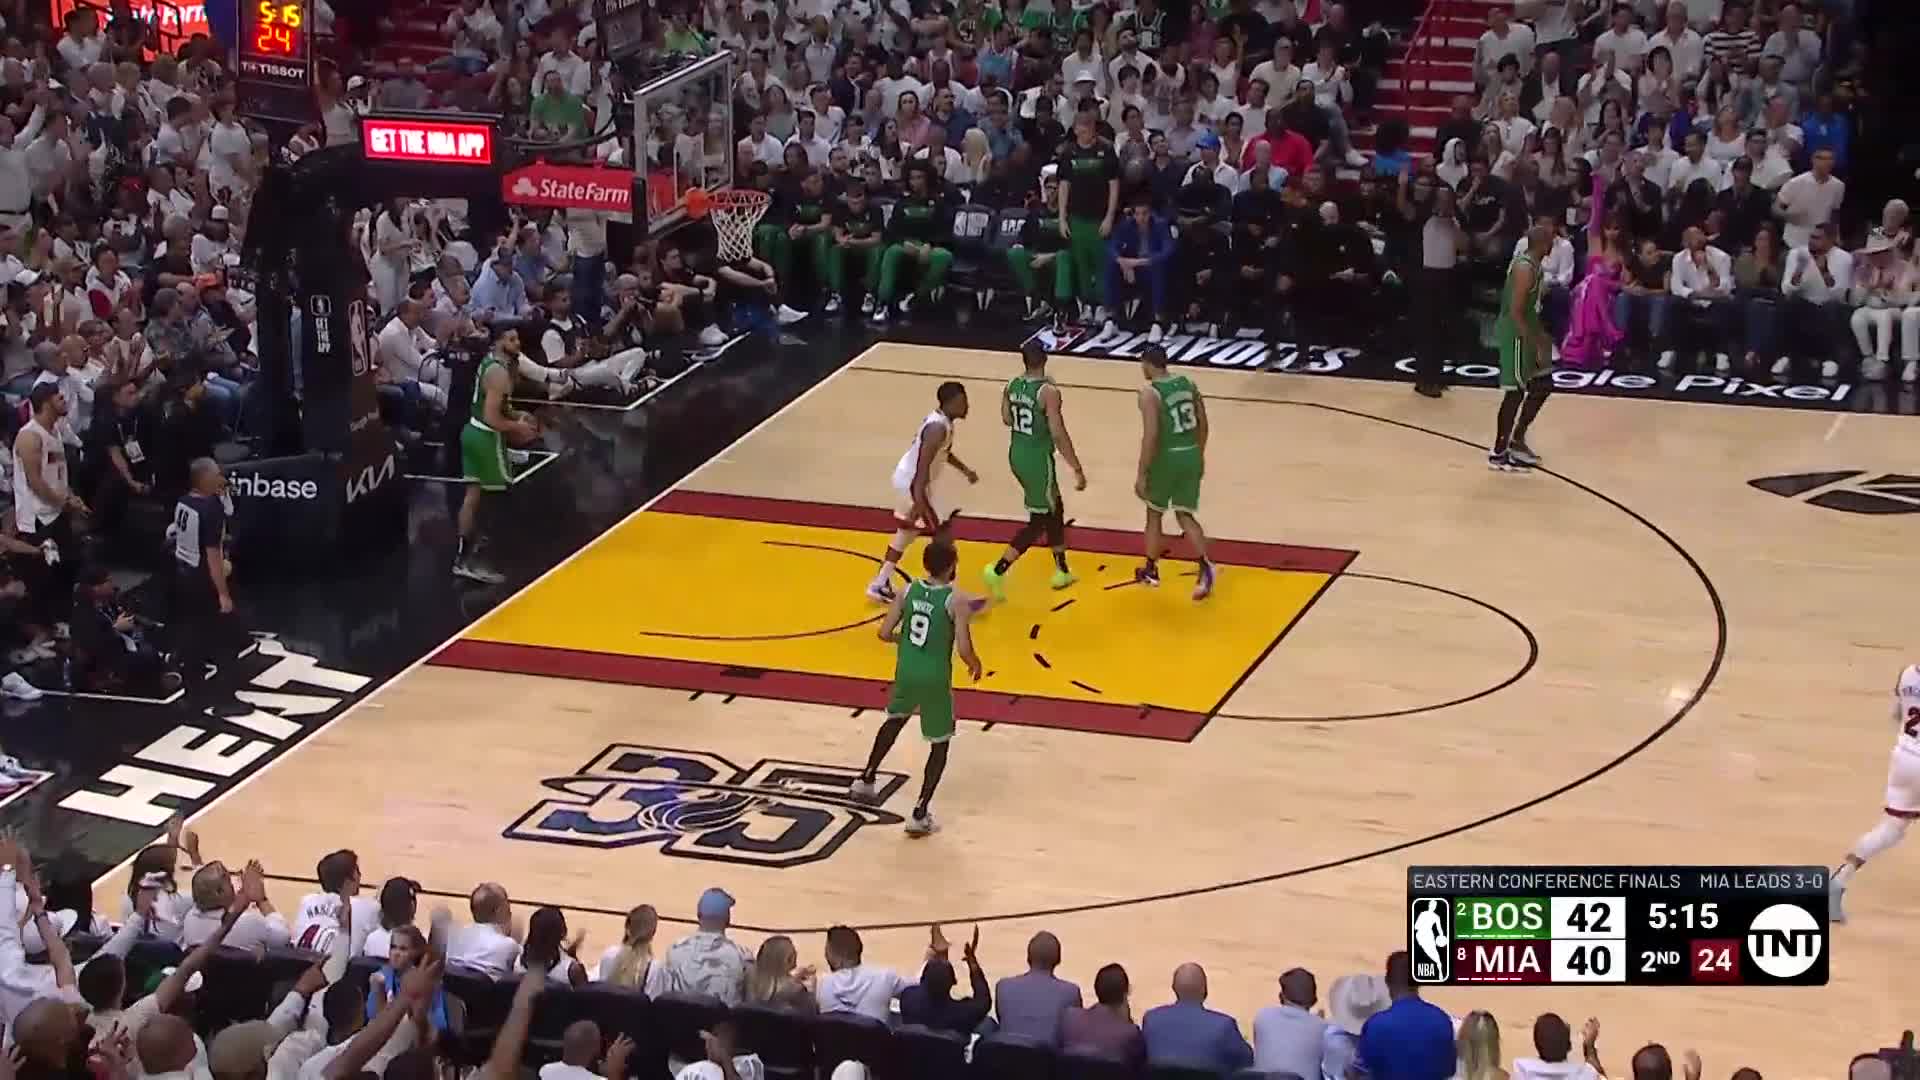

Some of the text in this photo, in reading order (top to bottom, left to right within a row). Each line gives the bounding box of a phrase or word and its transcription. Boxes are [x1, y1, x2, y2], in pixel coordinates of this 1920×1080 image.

[260, 1, 300, 27] 5:15
[258, 24, 290, 52] 24
[259, 64, 304, 79] TISSOT
[371, 128, 484, 157] GET THE NBA APP
[1394, 357, 1851, 402] Gogle Pixel
[1011, 405, 1033, 435] 12
[1170, 402, 1197, 432] 13
[229, 471, 318, 499] inbase
[909, 613, 930, 648] 9
[57, 632, 374, 827] HEAT
